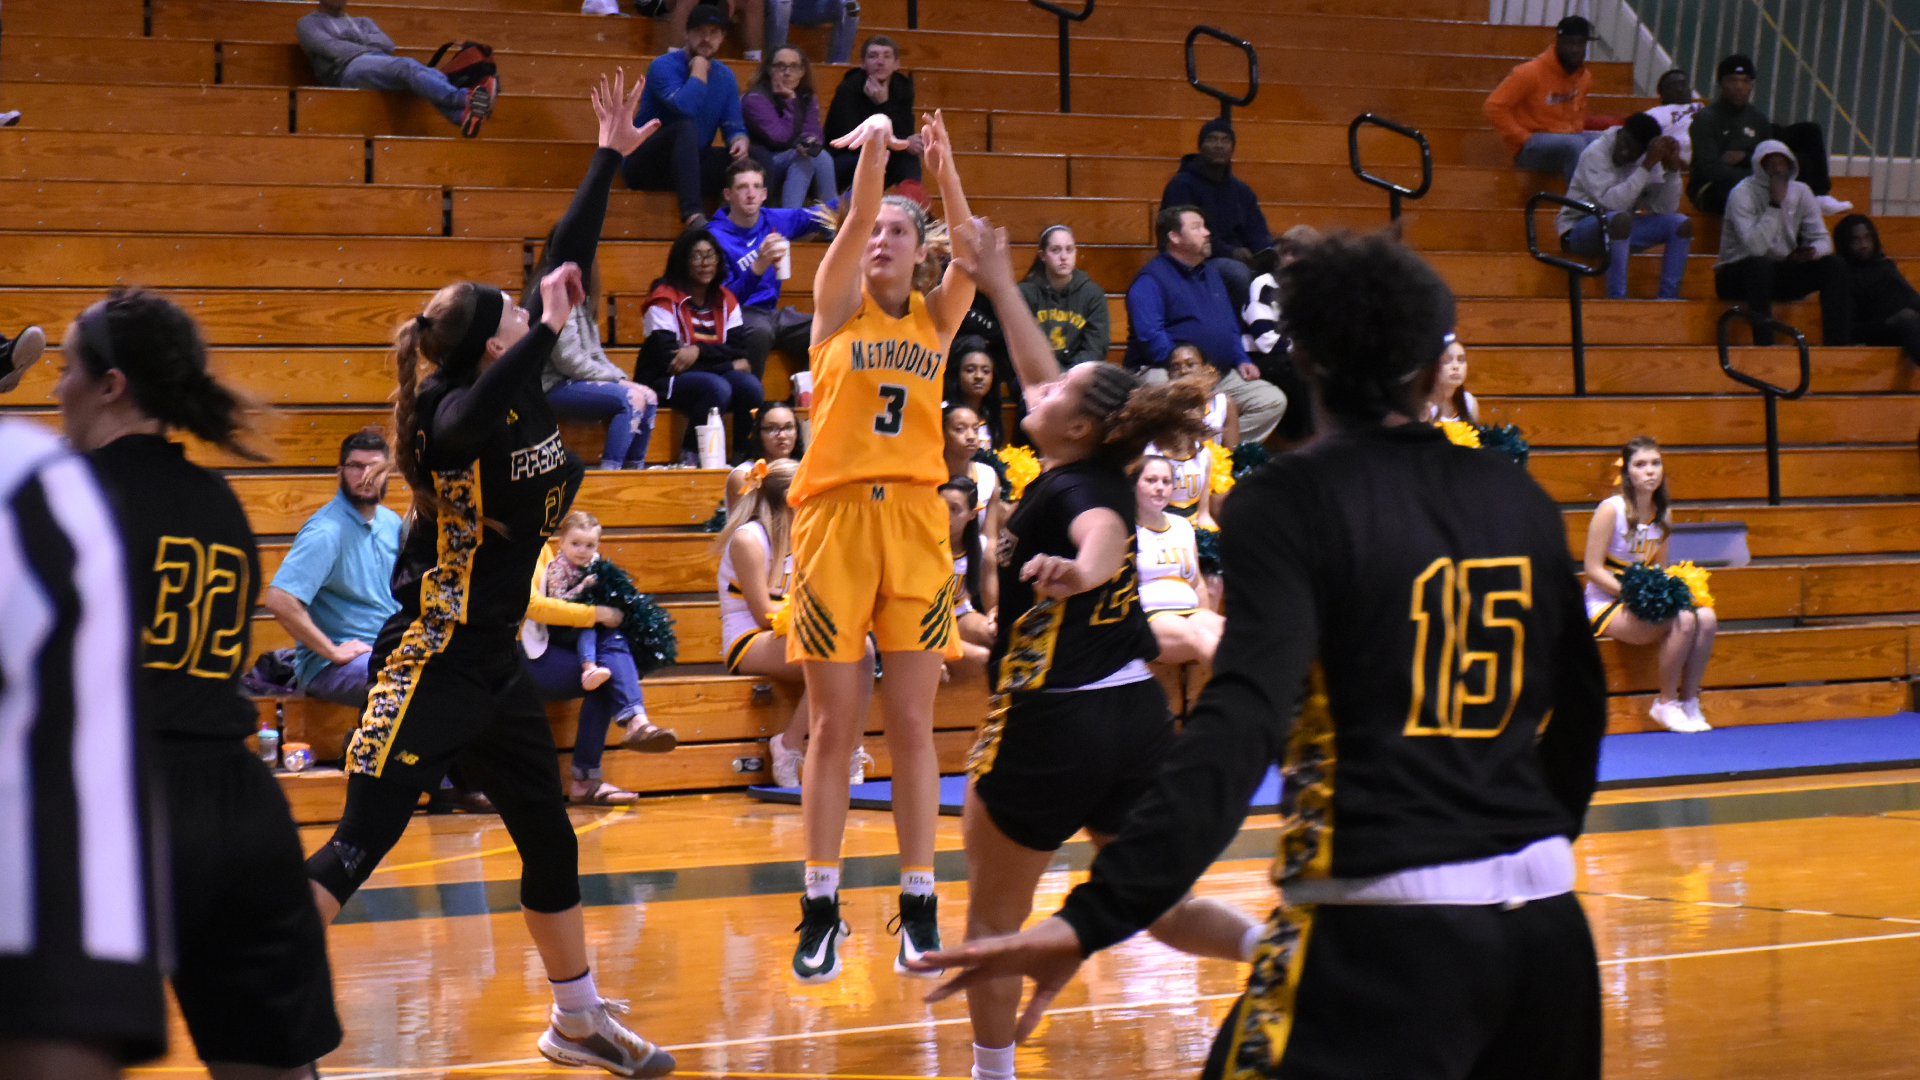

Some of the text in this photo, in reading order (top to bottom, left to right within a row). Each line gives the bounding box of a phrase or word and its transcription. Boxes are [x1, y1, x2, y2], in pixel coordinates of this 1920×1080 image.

[851, 338, 943, 382] METHODIST
[872, 382, 908, 437] 3
[539, 480, 567, 536] 2
[870, 484, 886, 502] M
[141, 535, 249, 680] 32
[1402, 556, 1533, 738] 15
